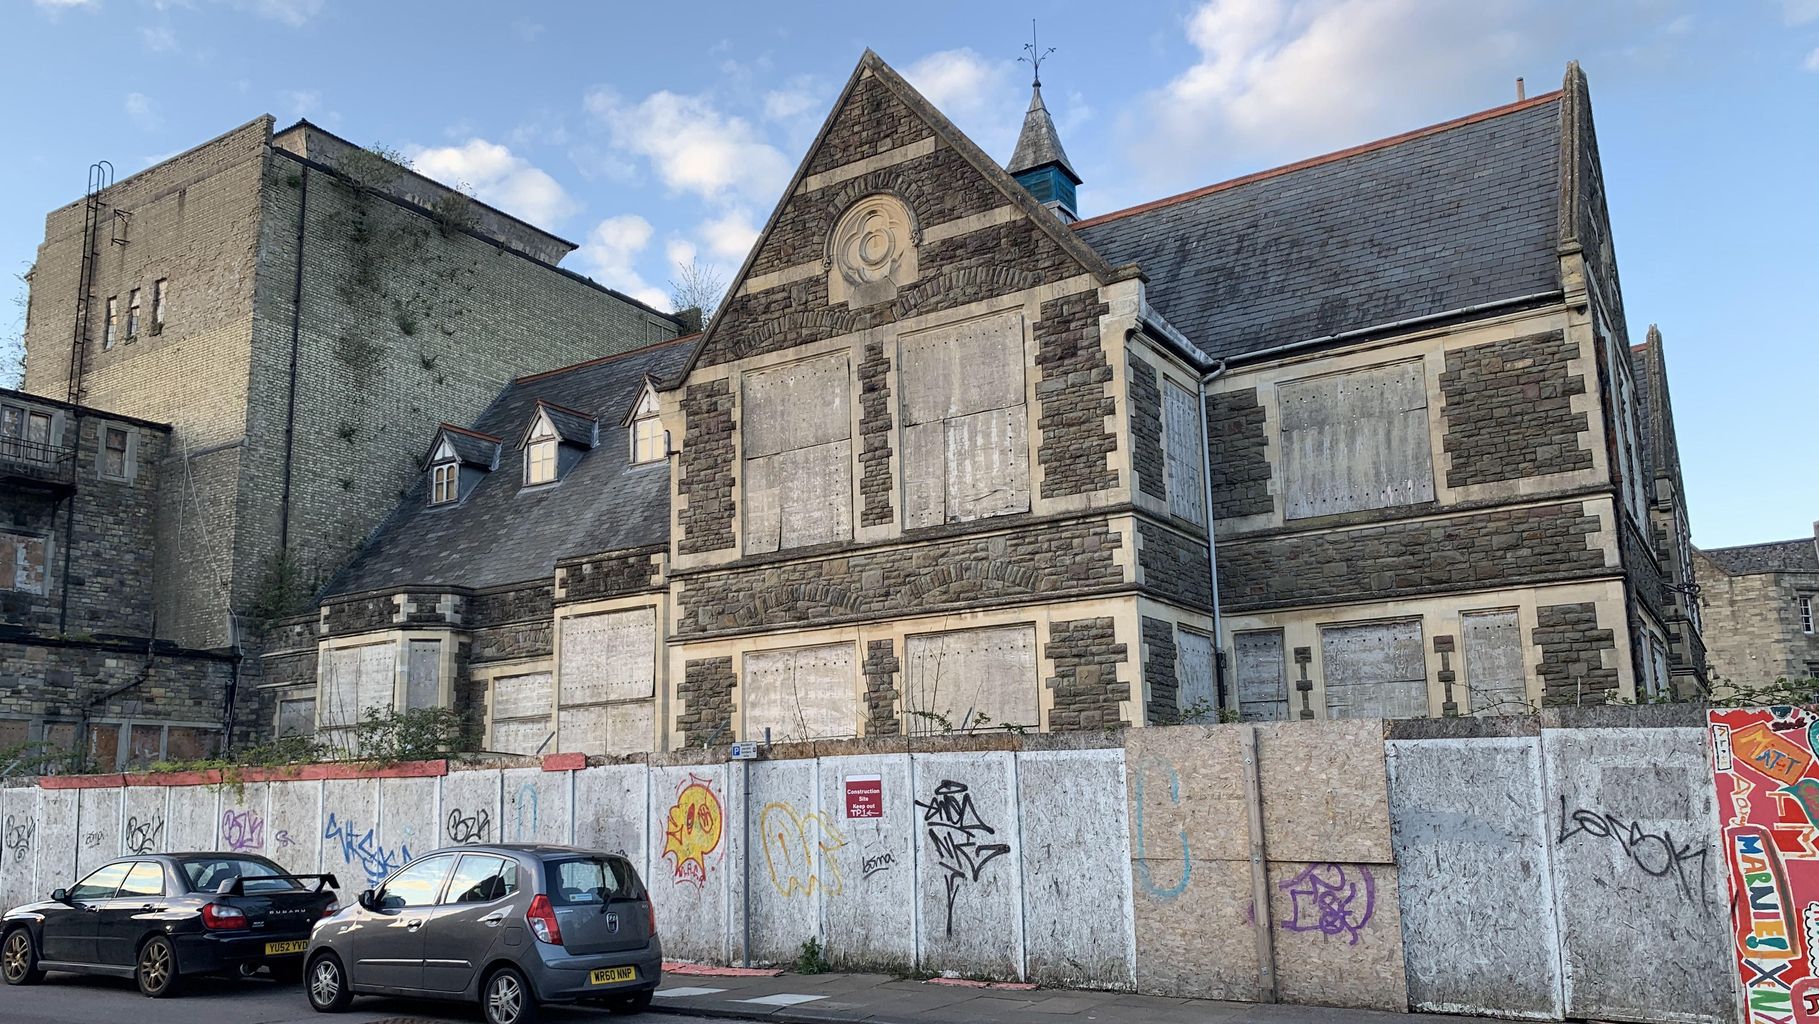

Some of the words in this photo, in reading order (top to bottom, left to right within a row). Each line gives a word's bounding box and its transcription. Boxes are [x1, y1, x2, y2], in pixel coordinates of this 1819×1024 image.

[1737, 835, 1789, 950] MARNIE!
[270, 943, 290, 953] YU52
[292, 941, 308, 951] YVD
[594, 970, 615, 982] WR60
[617, 968, 632, 979] NNP
